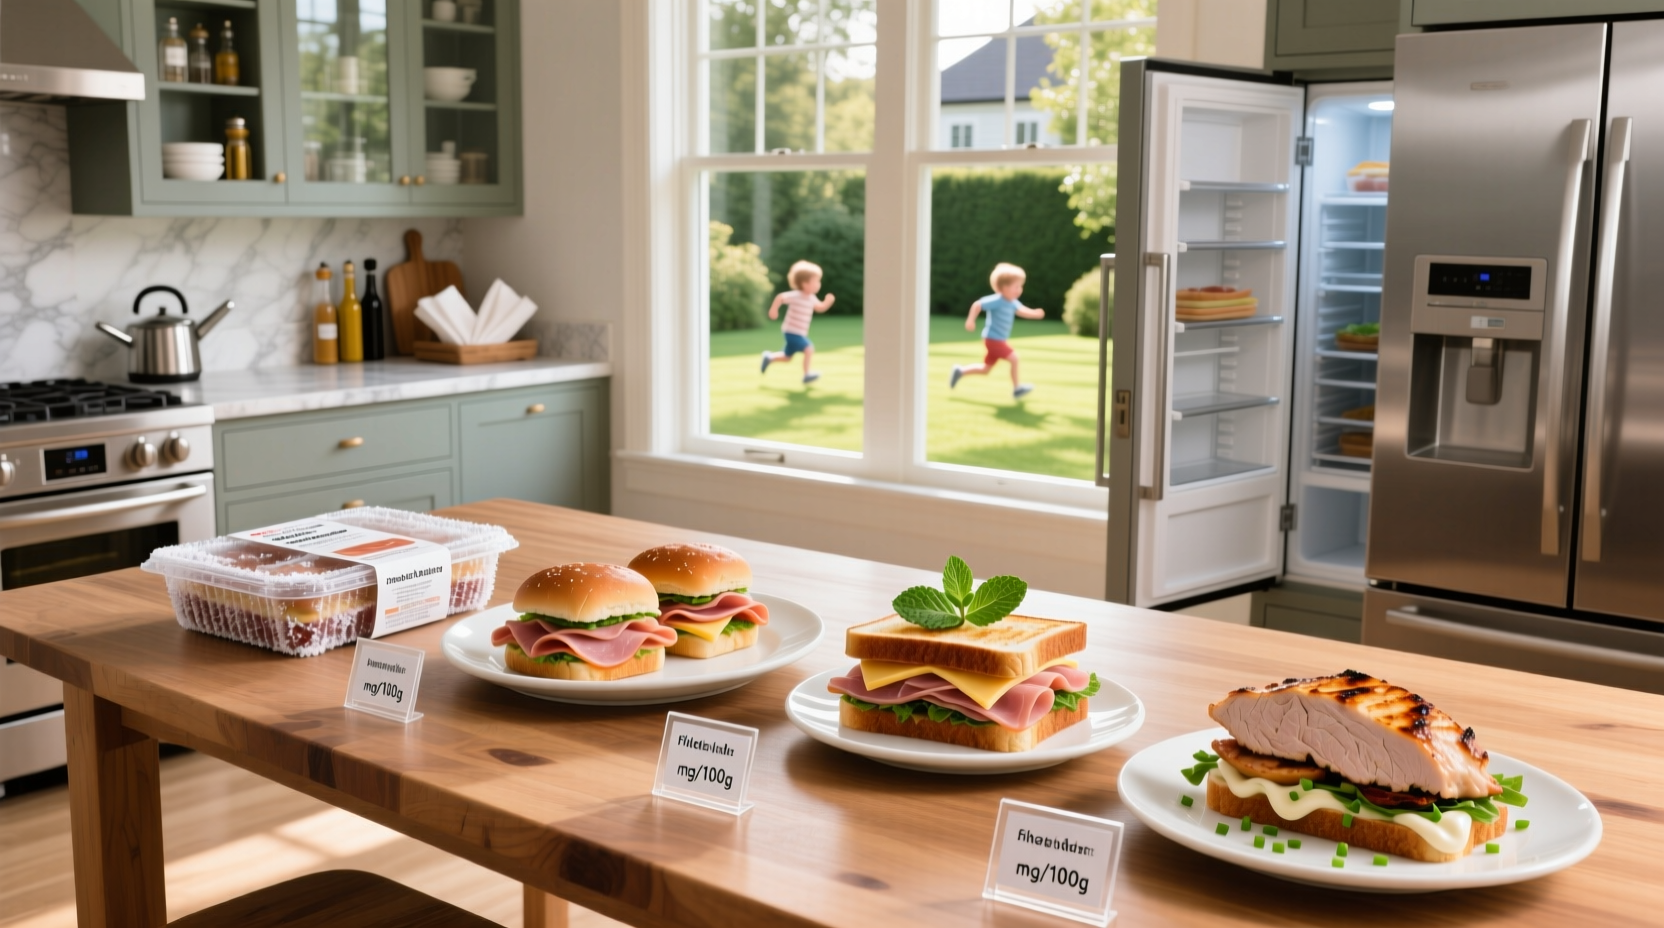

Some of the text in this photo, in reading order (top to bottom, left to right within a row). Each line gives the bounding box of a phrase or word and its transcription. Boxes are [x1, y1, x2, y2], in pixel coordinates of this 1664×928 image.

[363, 682, 403, 703] mg/100g
[677, 764, 733, 790] mg/100g
[1016, 863, 1089, 895] mg/100g
